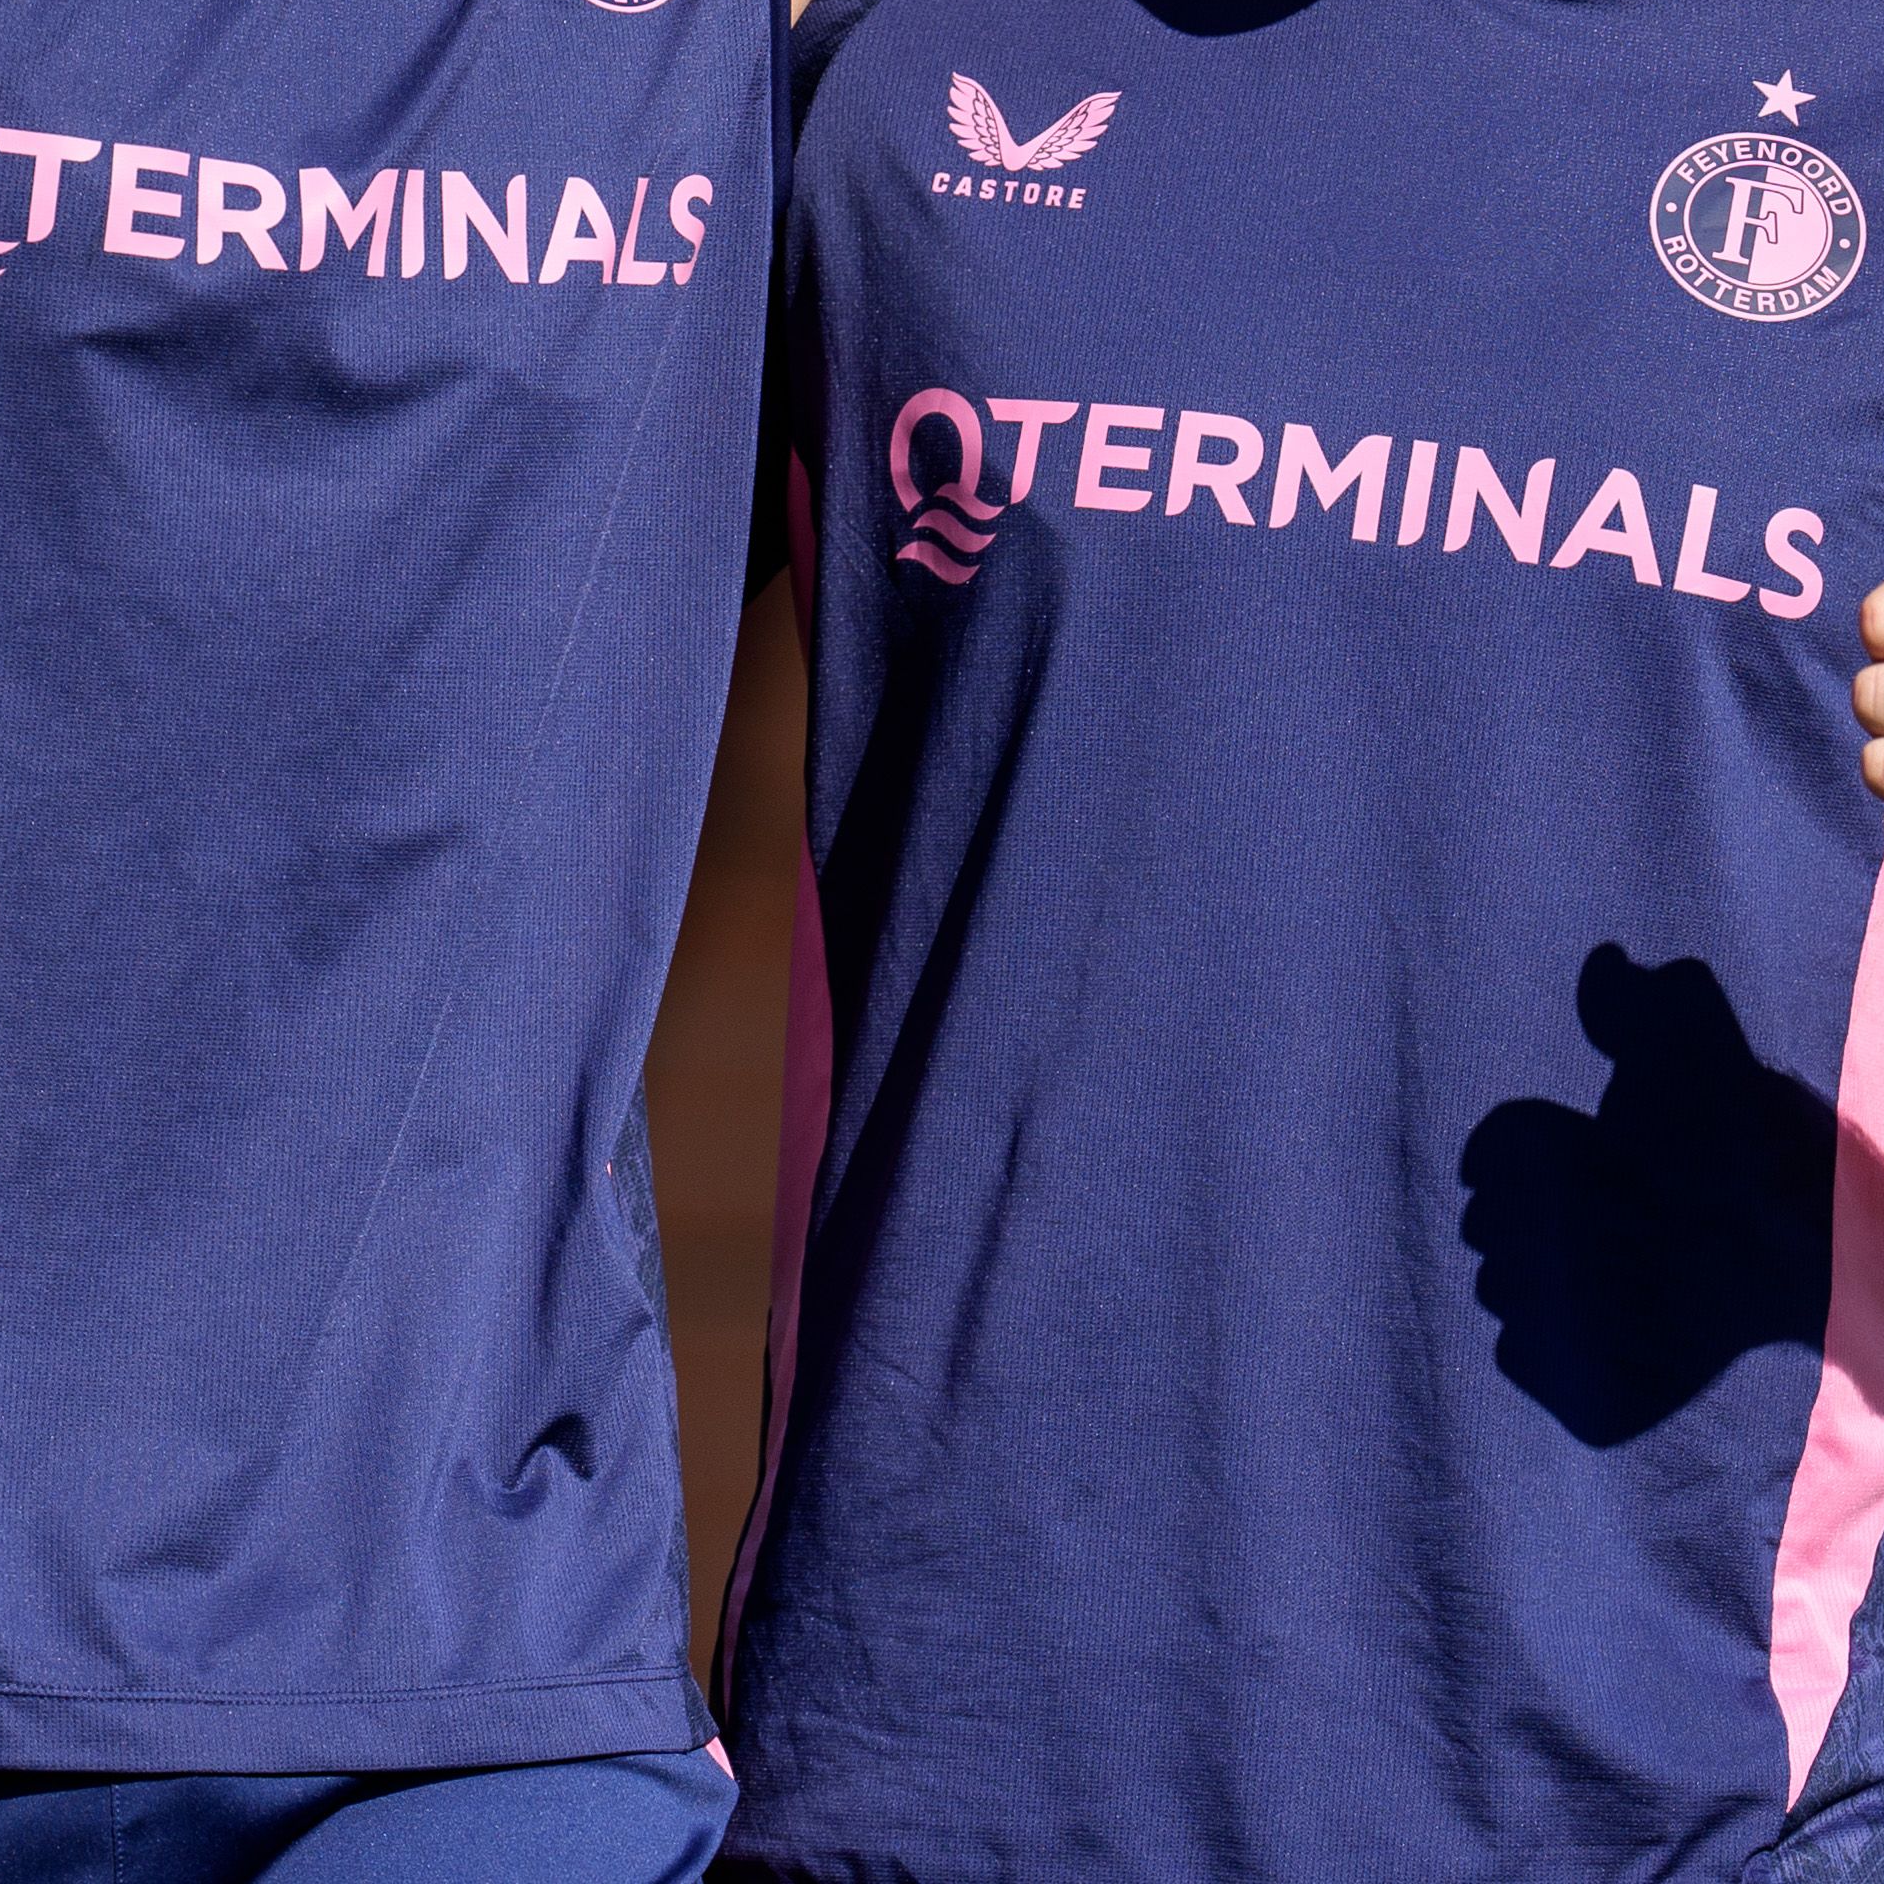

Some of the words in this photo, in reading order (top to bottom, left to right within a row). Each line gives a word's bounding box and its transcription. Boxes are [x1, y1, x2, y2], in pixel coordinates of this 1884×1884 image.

[931, 172, 1087, 209] CASTORE
[1676, 140, 1852, 216] FEYENOORD
[1712, 176, 1804, 265] F
[1663, 234, 1841, 313] ROTTERDAM
[889, 387, 1825, 619] QTERMINALS
